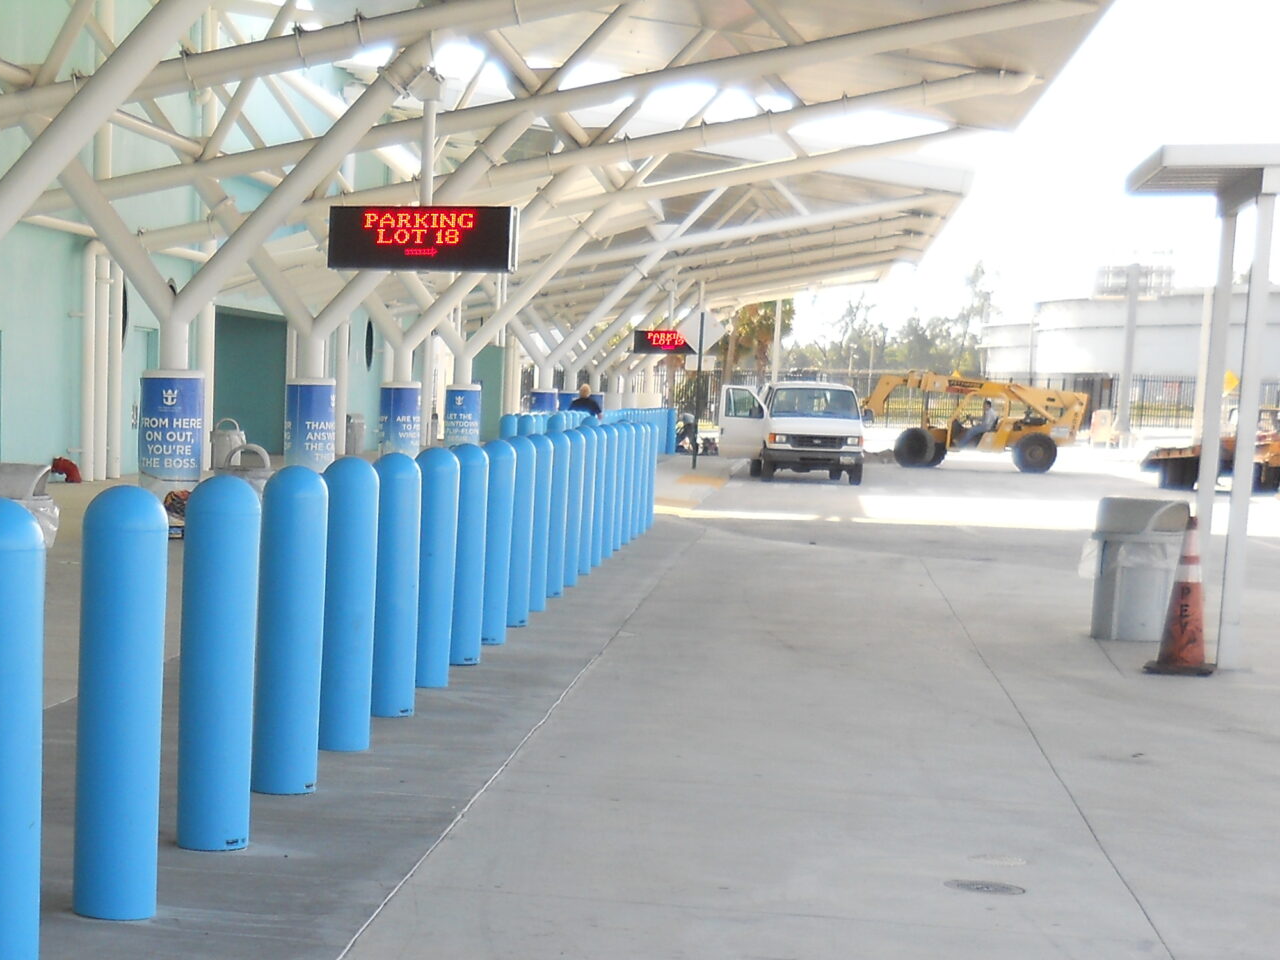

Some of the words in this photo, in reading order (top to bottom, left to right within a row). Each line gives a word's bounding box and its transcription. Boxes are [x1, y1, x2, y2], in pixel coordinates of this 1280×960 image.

[364, 213, 474, 228] PARKING
[376, 229, 427, 244] LOT
[435, 229, 460, 244] 18
[652, 337, 671, 345] LOT
[141, 417, 168, 428] FROM
[173, 417, 202, 429] HERE
[145, 431, 162, 442] ON
[166, 432, 194, 444] OUT,
[147, 444, 192, 456] YOU'RE
[304, 442, 324, 452] THE
[142, 457, 160, 468] THE
[164, 458, 198, 469] BOSS.
